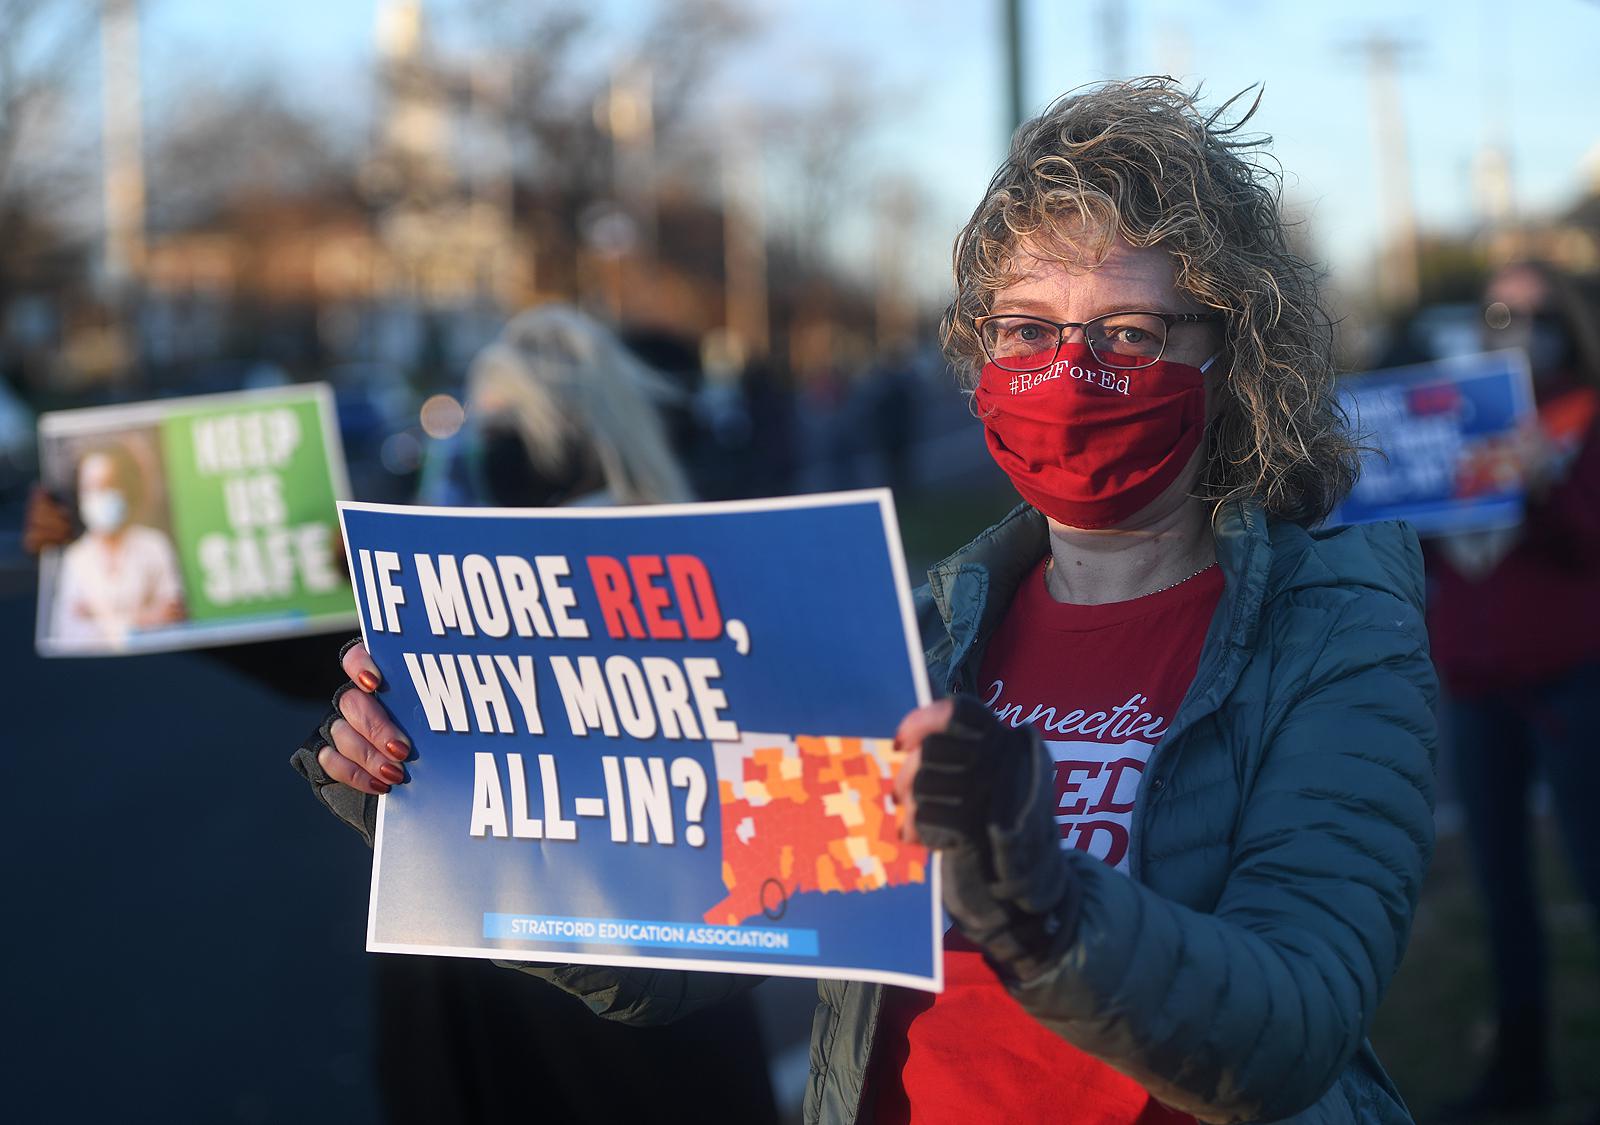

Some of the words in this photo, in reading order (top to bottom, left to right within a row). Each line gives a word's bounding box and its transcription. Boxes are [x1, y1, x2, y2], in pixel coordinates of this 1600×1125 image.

[1009, 360, 1130, 396] #RedForEd
[192, 409, 300, 473] KEEP
[224, 473, 287, 528] US
[199, 523, 335, 604] SAFE
[358, 549, 406, 633] IF
[414, 553, 588, 638] MORE
[587, 555, 751, 655] RED,
[403, 653, 543, 734] WHY
[550, 656, 740, 741] MORE
[470, 752, 708, 848] ALL-IN?
[1053, 757, 1145, 815] ED
[511, 919, 595, 938] STRATFORD
[598, 922, 684, 943] EDUCATION
[686, 926, 789, 949] ASSOCIATION
